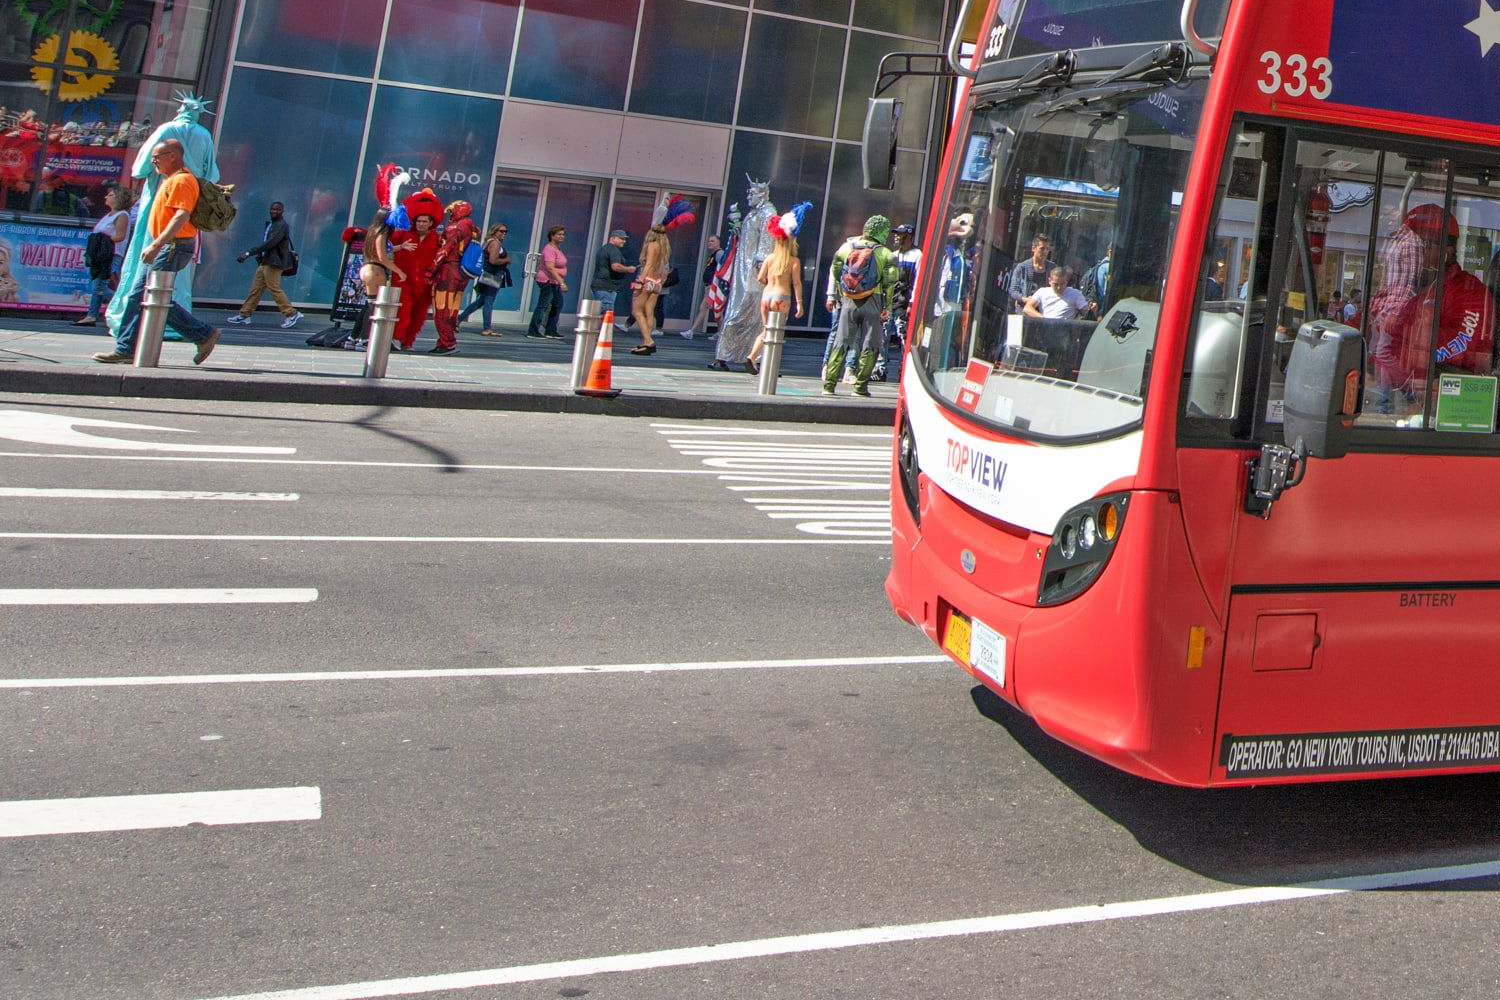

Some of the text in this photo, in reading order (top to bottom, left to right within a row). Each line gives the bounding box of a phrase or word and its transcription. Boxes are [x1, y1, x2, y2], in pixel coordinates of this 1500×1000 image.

[985, 23, 1007, 58] 333
[1257, 50, 1334, 101] 333
[433, 183, 464, 191] TRUST
[20, 243, 86, 270] WAITRE
[1443, 380, 1460, 388] NYC
[1464, 382, 1479, 393] SSB
[947, 438, 1008, 492] TOPVIEW
[1400, 593, 1457, 608] BATTERY
[1227, 740, 1286, 772] OPERATOR:
[1286, 739, 1301, 769] GO
[1302, 738, 1329, 768] NEW
[1328, 737, 1356, 767] YORK
[1355, 735, 1389, 765] TOURS
[1388, 734, 1407, 768] INC,
[1407, 733, 1440, 763] USDOT
[1446, 731, 1481, 761] 2114416
[1480, 730, 1500, 759] DBA
